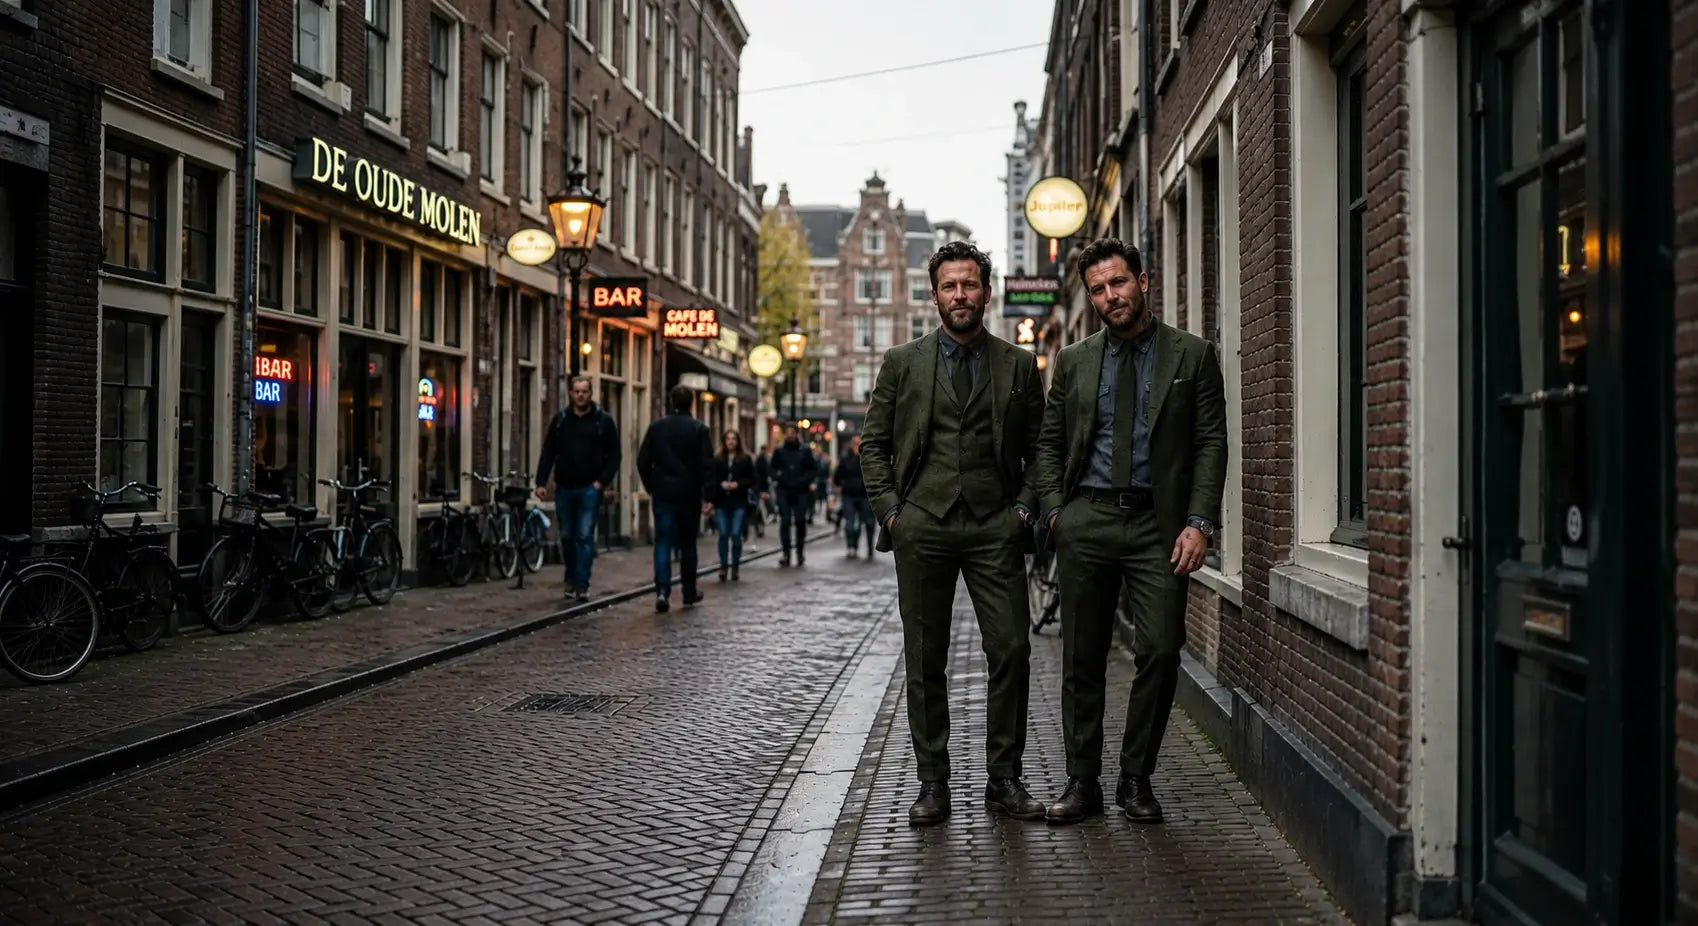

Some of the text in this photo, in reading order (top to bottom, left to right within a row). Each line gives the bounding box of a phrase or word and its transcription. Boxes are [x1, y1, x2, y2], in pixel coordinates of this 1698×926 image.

[312, 137, 481, 246] DE OUDE MOLEN
[594, 287, 642, 306] BAR
[699, 309, 714, 322] DE
[663, 322, 718, 337] MOLEN
[255, 380, 281, 402] BAR
